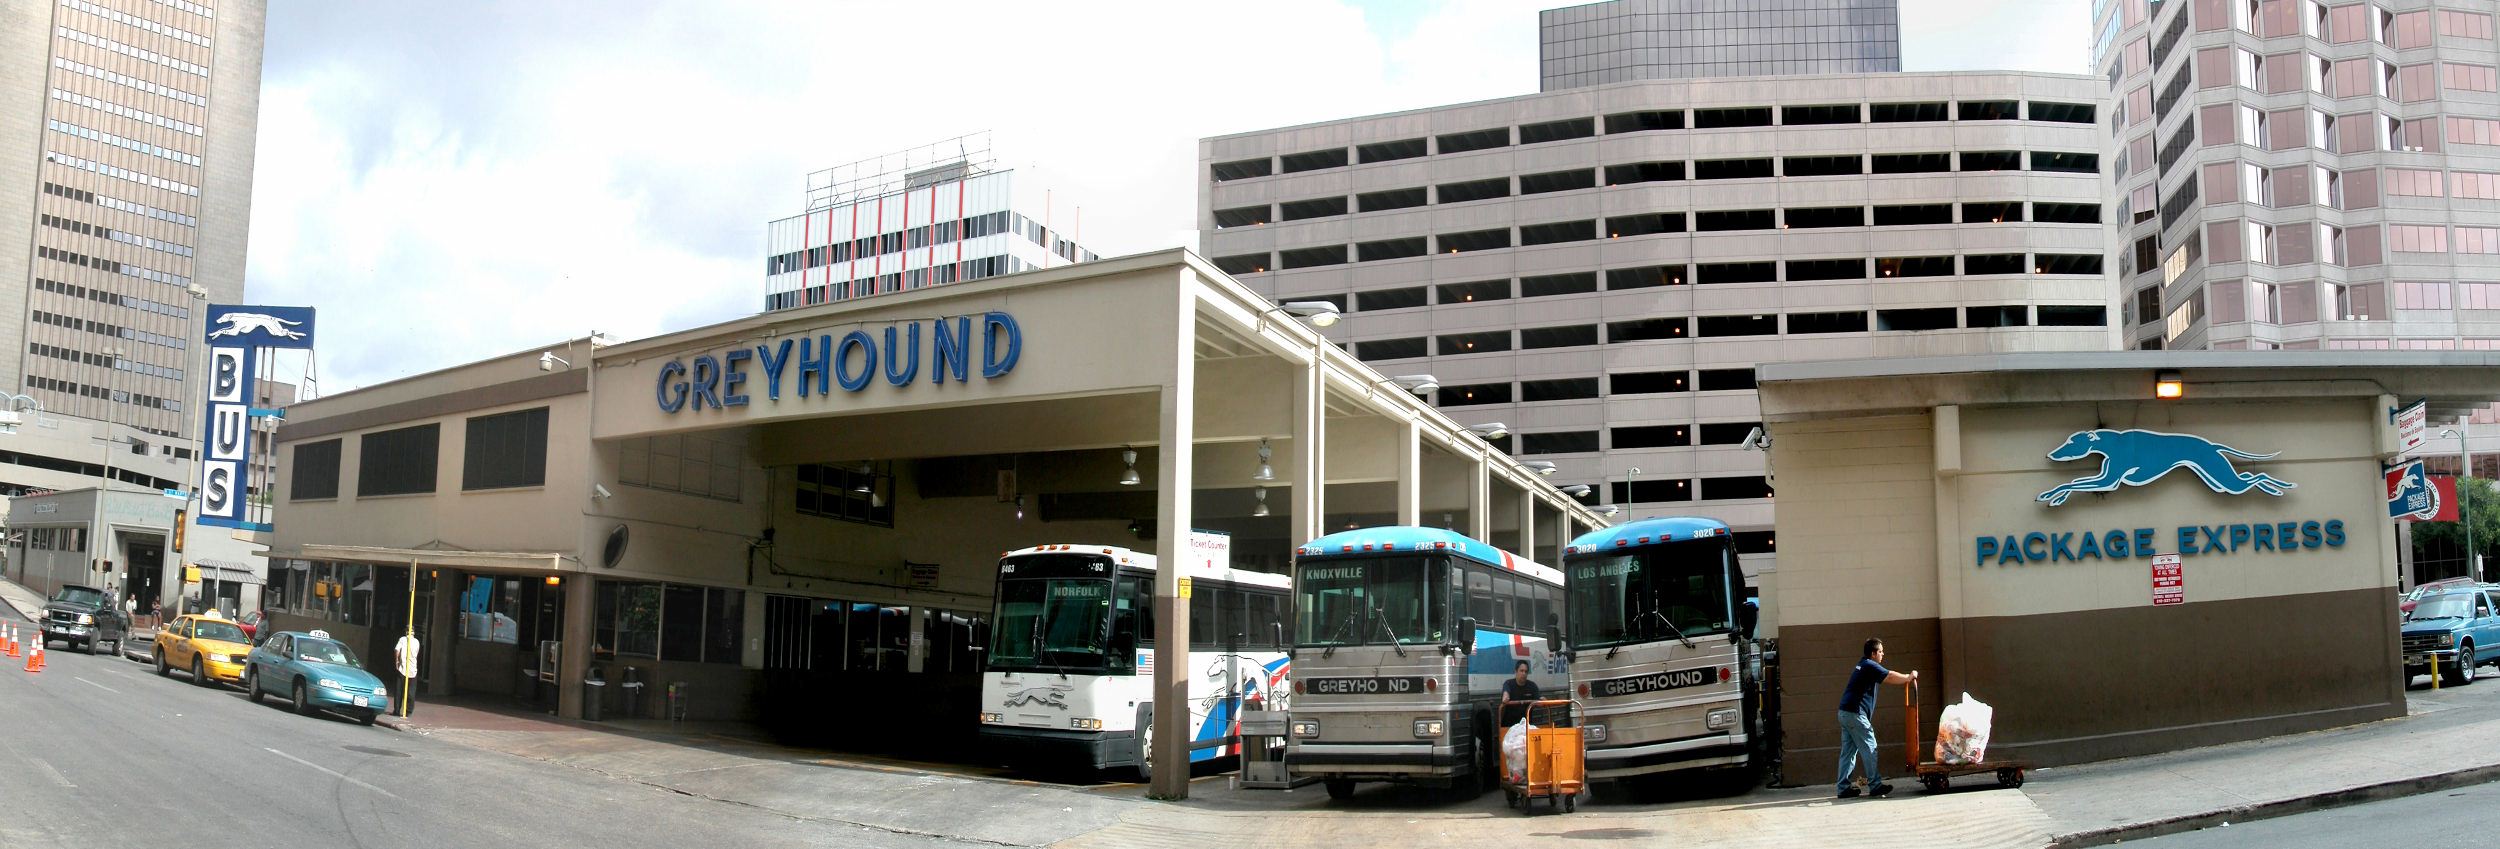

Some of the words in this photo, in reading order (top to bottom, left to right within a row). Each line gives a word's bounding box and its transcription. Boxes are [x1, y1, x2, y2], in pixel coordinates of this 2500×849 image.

[656, 311, 1022, 414] GREYHOUND
[206, 353, 240, 512] BUS
[2408, 492, 2425, 504] PACKAGE
[2408, 501, 2426, 511] EXPRESS
[1693, 527, 1714, 538] 3020
[1415, 541, 1435, 551] 2325
[1576, 543, 1597, 553] 3020
[1976, 528, 2156, 566] PACKAGE
[2177, 519, 2347, 555] EXPRESS
[1306, 567, 1363, 580] KNOXVILLE
[1578, 566, 1596, 580] LOS
[1600, 560, 1640, 577] ANGELES
[1054, 586, 1101, 597] NORFOLK
[1605, 670, 1703, 696] GREYHOUND
